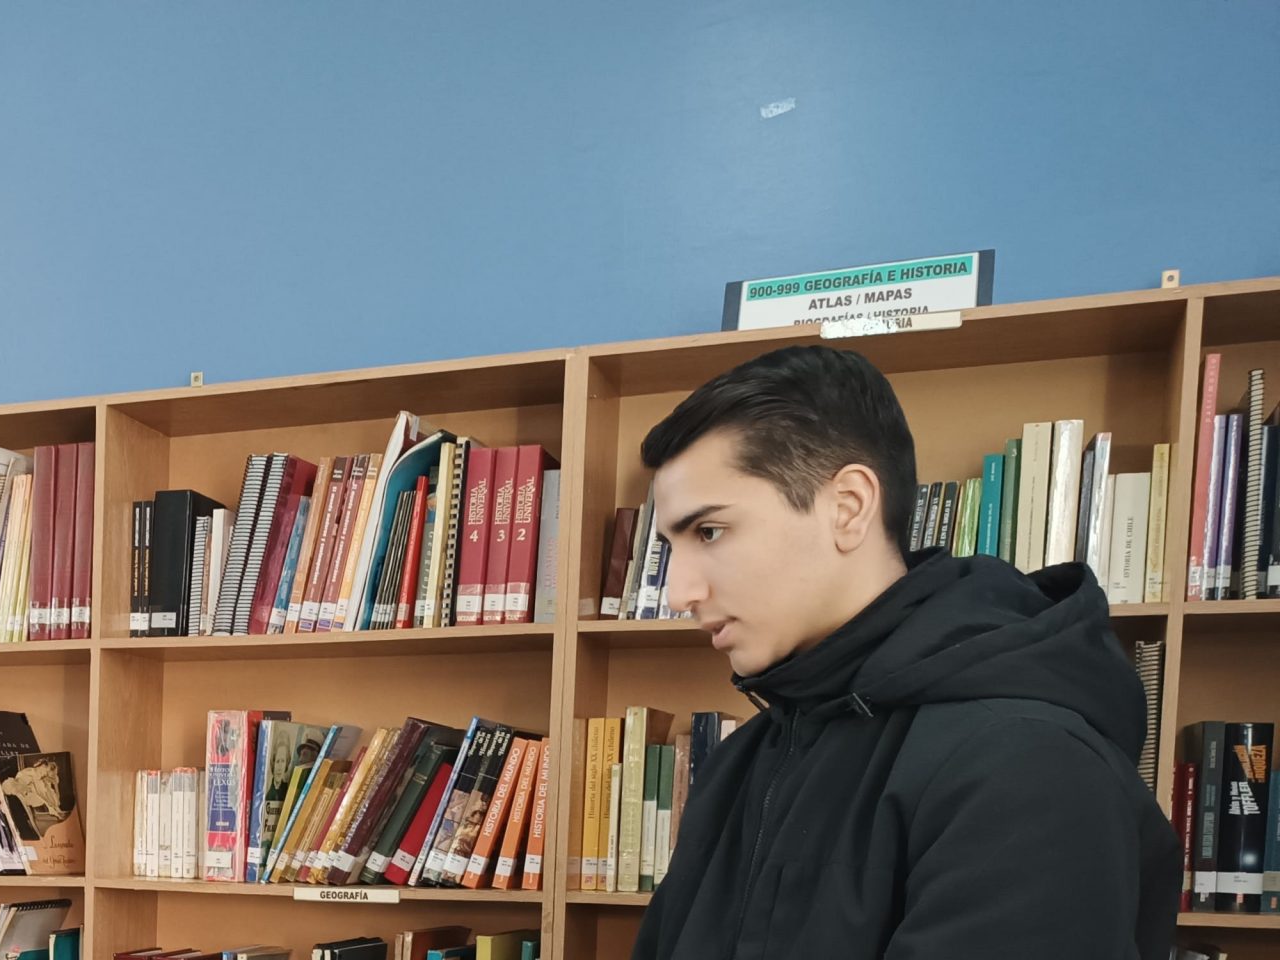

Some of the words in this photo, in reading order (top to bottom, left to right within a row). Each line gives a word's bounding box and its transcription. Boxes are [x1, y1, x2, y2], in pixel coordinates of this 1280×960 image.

[749, 281, 800, 299] 900-999
[804, 270, 884, 292] GEOGRAFÍA
[887, 270, 896, 281] E
[900, 262, 968, 280] HISTORIA
[808, 295, 853, 311] ATLAS
[864, 288, 913, 304] MAPAS
[468, 487, 479, 525] HISTORIA
[476, 478, 488, 525] UNIVERSAL
[494, 487, 505, 525] HISTORIA
[502, 477, 514, 525] UNIVERSAL
[515, 485, 526, 523] HISTORIA
[523, 476, 535, 523] UNIVERSAL
[470, 530, 479, 542] 4
[496, 530, 505, 542] 3
[517, 528, 526, 540] 2
[1126, 516, 1134, 537] CHILE
[1126, 540, 1132, 549] DE
[541, 745, 550, 780] MUNDO
[483, 799, 502, 837] HISTORIA
[497, 783, 509, 798] DEL
[503, 748, 520, 781] MUNDO
[512, 791, 526, 823] HISTORIA
[520, 777, 530, 789] DEL
[525, 746, 536, 775] MUNDO
[539, 783, 548, 797] DEL
[1239, 781, 1261, 815] TOFFLER
[533, 799, 545, 838] HISTORIA
[320, 889, 369, 900] GEOGRAFÍA
